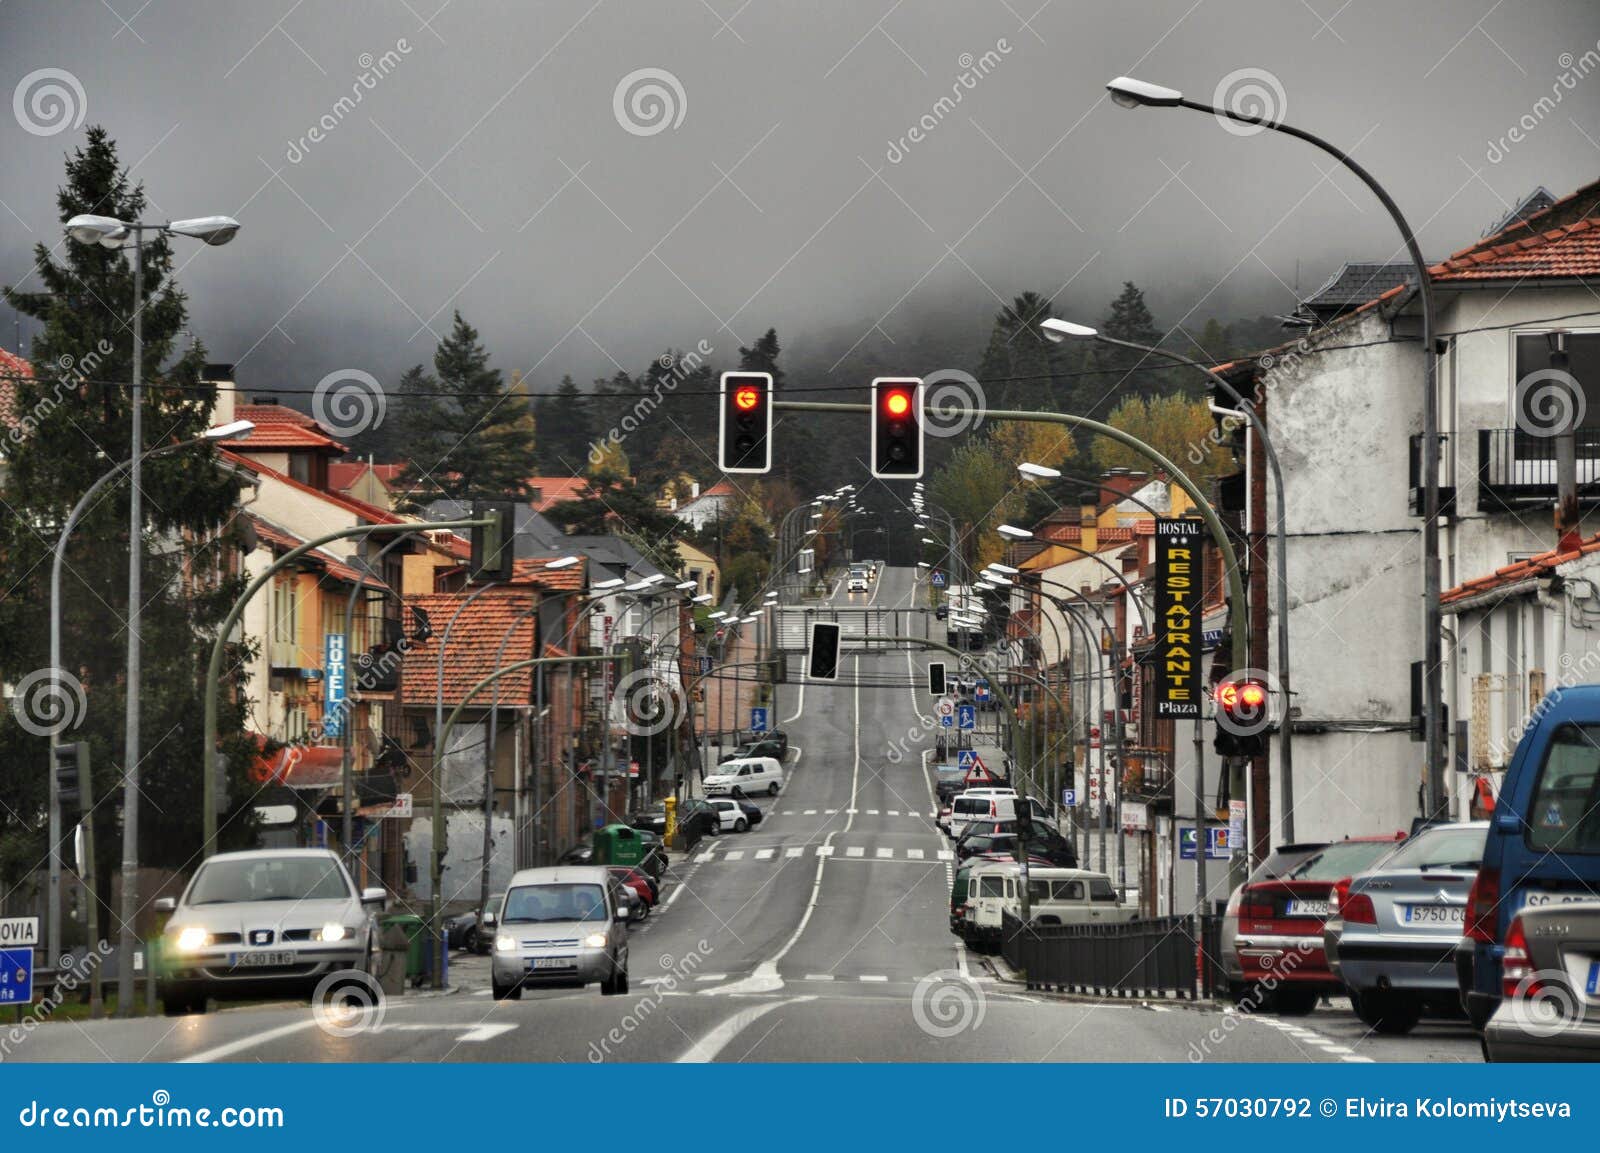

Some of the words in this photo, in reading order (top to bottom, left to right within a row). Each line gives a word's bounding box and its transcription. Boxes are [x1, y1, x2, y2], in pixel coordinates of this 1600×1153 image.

[1159, 523, 1199, 535] HOSTAL
[1166, 549, 1191, 700] RESTAURANTE
[328, 635, 345, 702] HOTEL
[1159, 702, 1198, 714] Plaza
[1414, 906, 1448, 921] 5750
